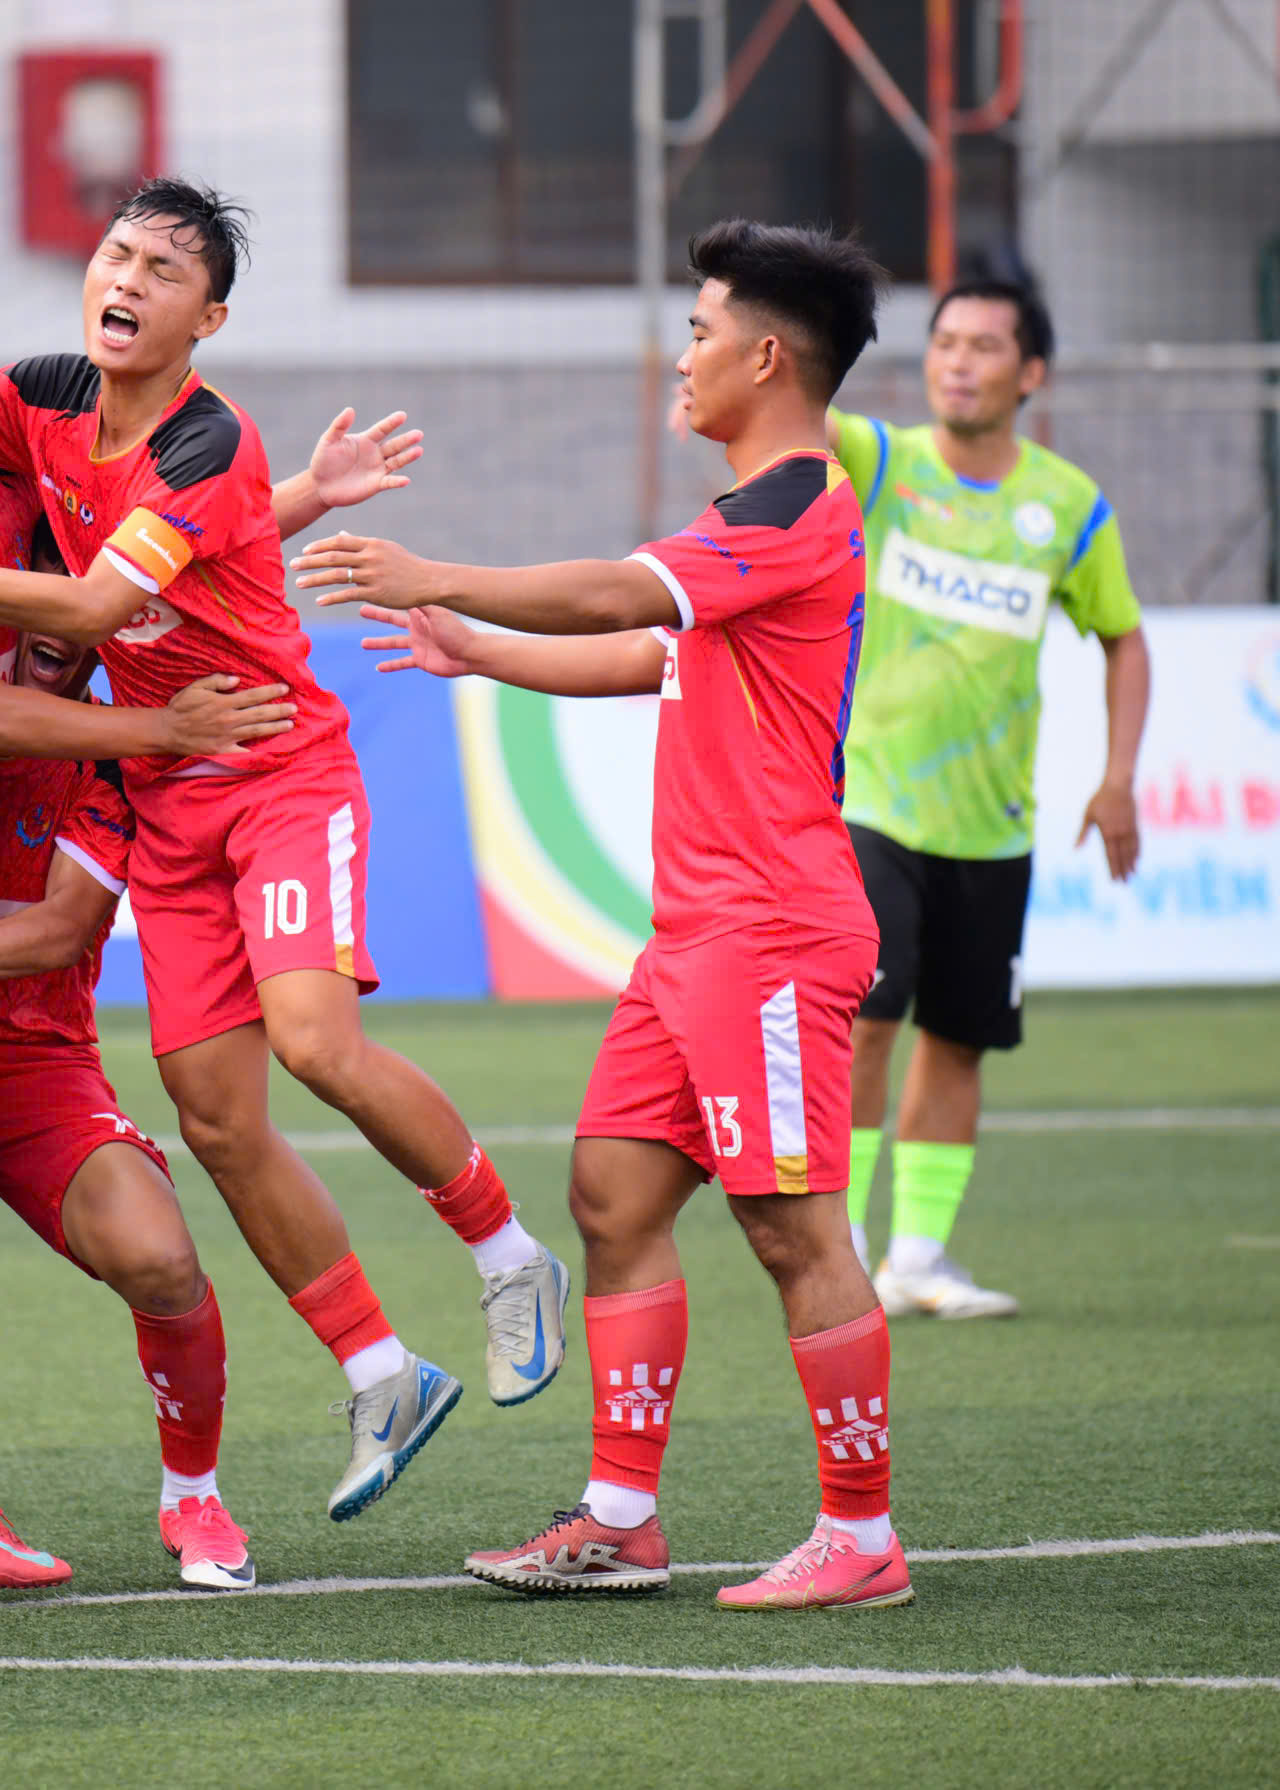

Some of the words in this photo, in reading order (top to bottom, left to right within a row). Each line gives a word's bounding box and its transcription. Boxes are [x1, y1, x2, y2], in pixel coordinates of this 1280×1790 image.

[899, 552, 1031, 617] THACO
[262, 879, 308, 939] 10
[702, 1096, 742, 1157] 13
